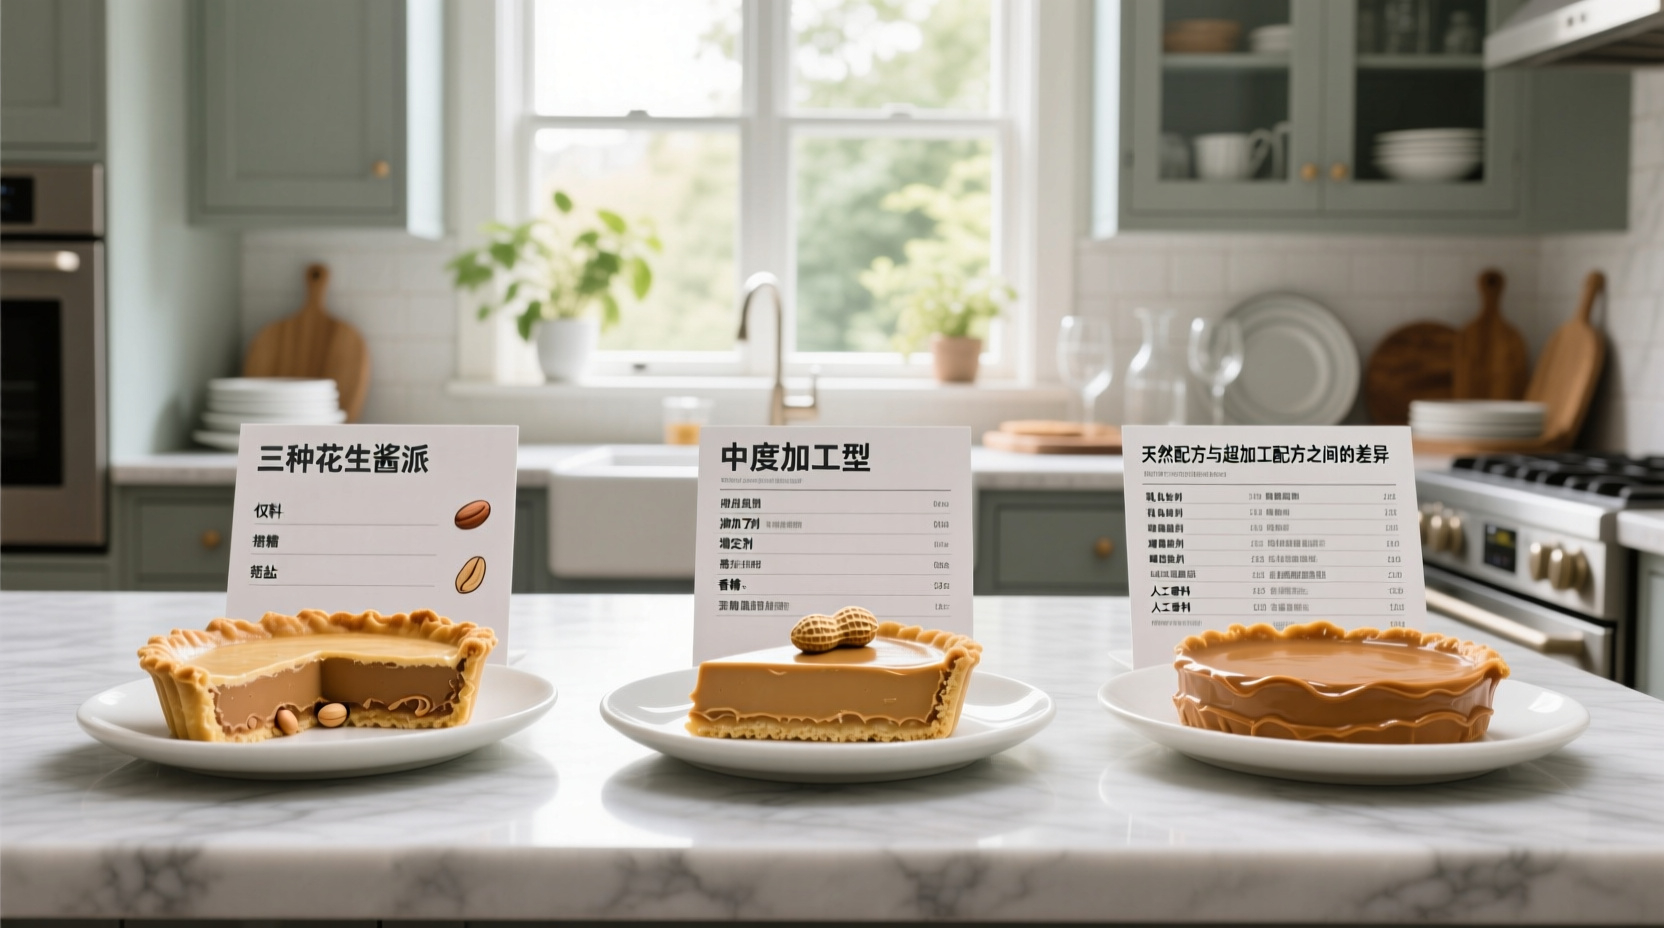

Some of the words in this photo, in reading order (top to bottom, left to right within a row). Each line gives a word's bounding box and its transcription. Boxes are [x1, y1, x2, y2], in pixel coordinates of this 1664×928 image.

[258, 443, 429, 473] 三种花生酱派
[722, 442, 870, 472] 中度加工型
[1142, 444, 1389, 464] 天然配方与超加工配方之间的差异
